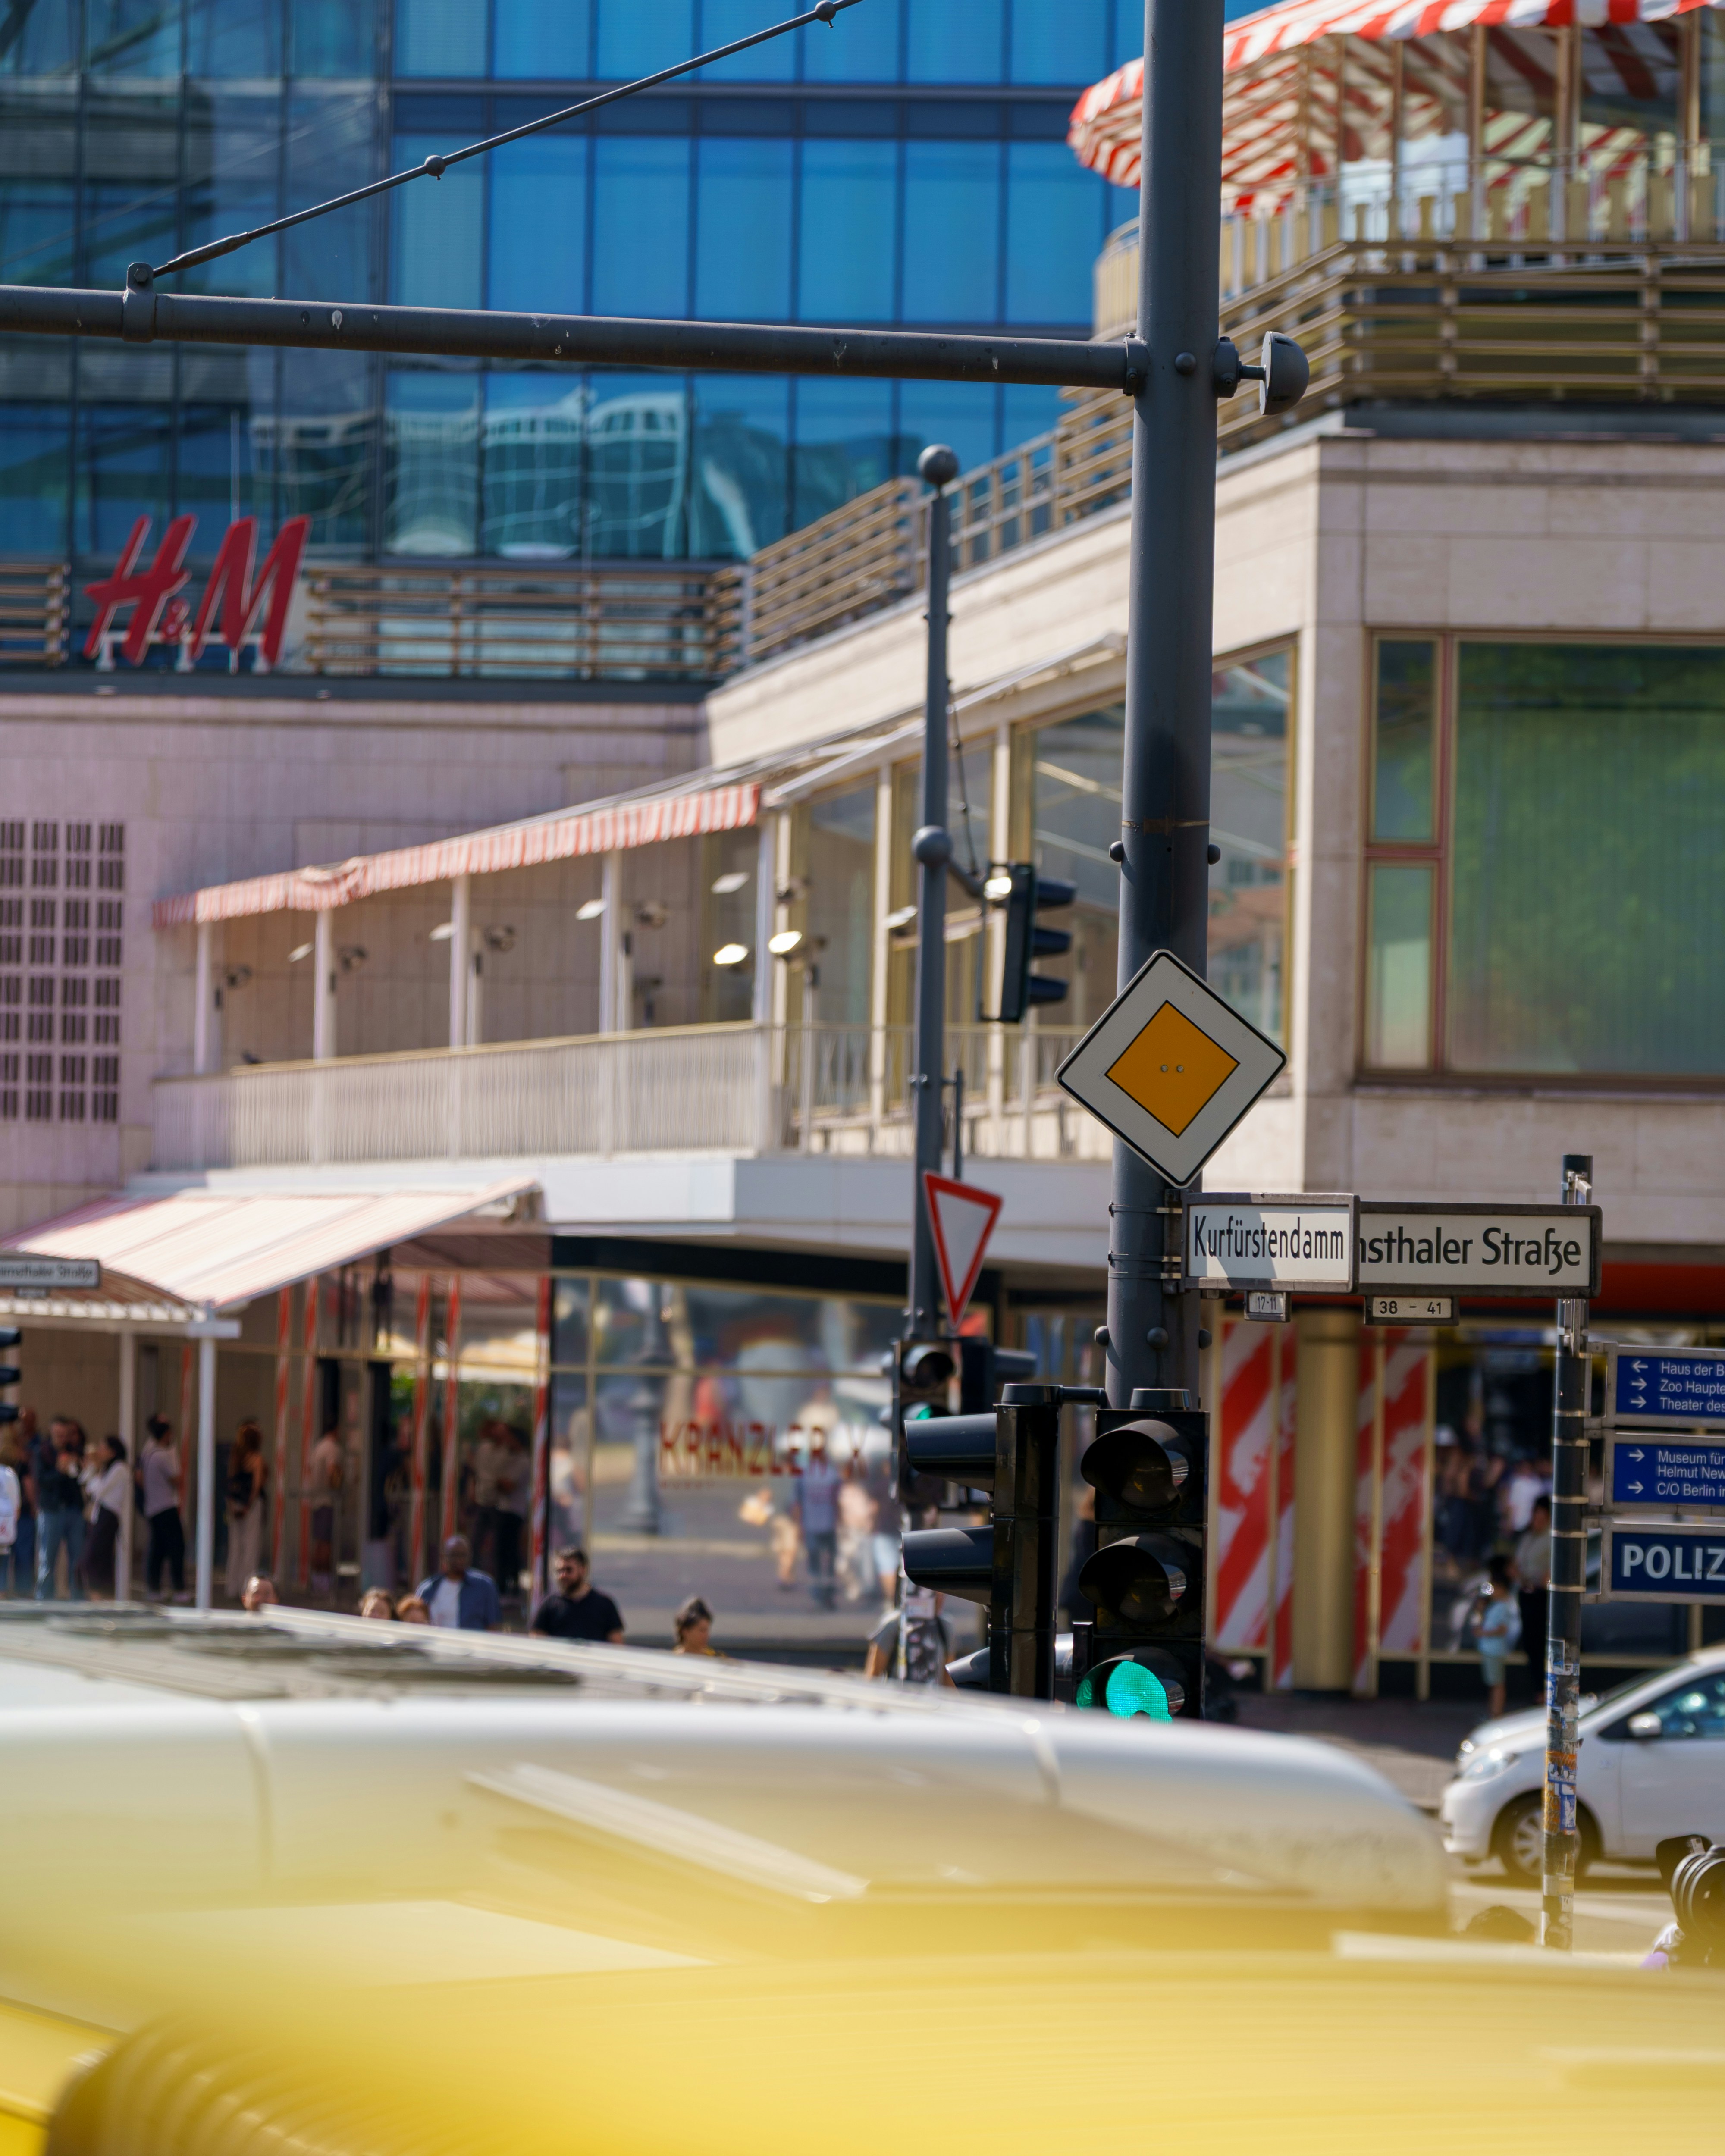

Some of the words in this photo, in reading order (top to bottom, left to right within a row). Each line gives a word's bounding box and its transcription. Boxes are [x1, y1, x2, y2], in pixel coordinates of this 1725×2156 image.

[83, 513, 311, 667] H&M
[1194, 1215, 1344, 1259] Kurfürstendamm
[1482, 1227, 1581, 1275] Straße
[1257, 1296, 1277, 1310] 17-11
[1379, 1300, 1398, 1315] 38
[1427, 1301, 1442, 1315] 41
[1661, 1361, 1690, 1375] Haus
[1694, 1363, 1713, 1376] der
[1716, 1363, 1725, 1377] B
[1660, 1379, 1682, 1393] Zoo
[1686, 1380, 1725, 1397] Haupte
[1660, 1397, 1704, 1411] Theater
[659, 1420, 829, 1478] KRANZLER
[1658, 1451, 1706, 1464] Museum
[1710, 1452, 1725, 1465] für
[1658, 1465, 1698, 1479] Helmut
[1657, 1482, 1680, 1496] C/O
[1683, 1483, 1716, 1497] Berlin
[1622, 1545, 1725, 1581] POLIZ
